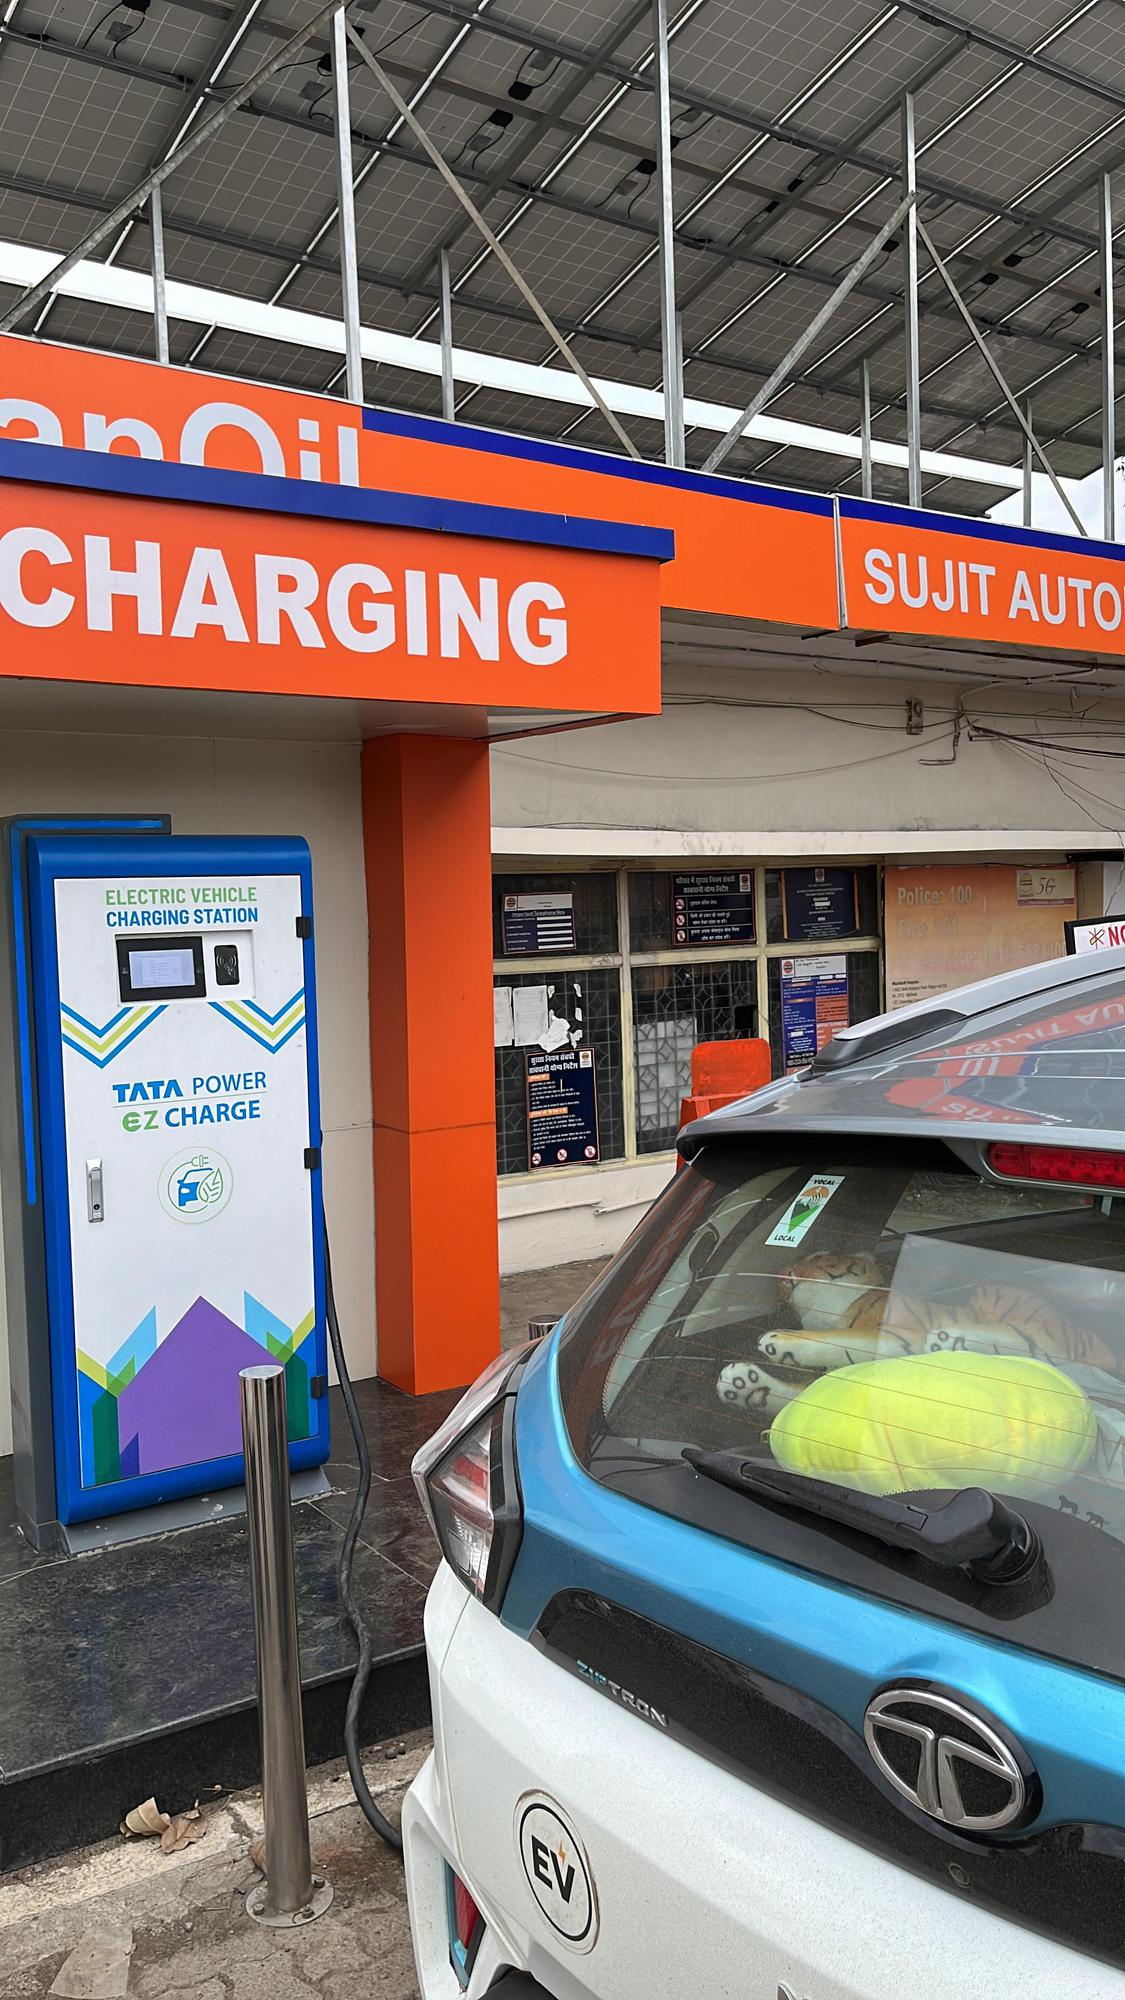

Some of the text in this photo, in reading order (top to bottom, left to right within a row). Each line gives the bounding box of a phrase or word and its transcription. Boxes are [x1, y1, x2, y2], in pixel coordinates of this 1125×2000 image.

[0, 527, 567, 665] CHARGING
[864, 548, 1125, 632] SUJIT AUTO
[105, 887, 257, 906] ELECTRIC VEHICLE
[950, 885, 972, 905] 100
[106, 907, 258, 927] CHARGING STATION
[112, 1071, 267, 1103] TATA POWER
[164, 1100, 261, 1128] CHARGE
[774, 1234, 795, 1242] LOCAL
[576, 1659, 667, 1727] ZIPTRON
[531, 1834, 575, 1904] EV
